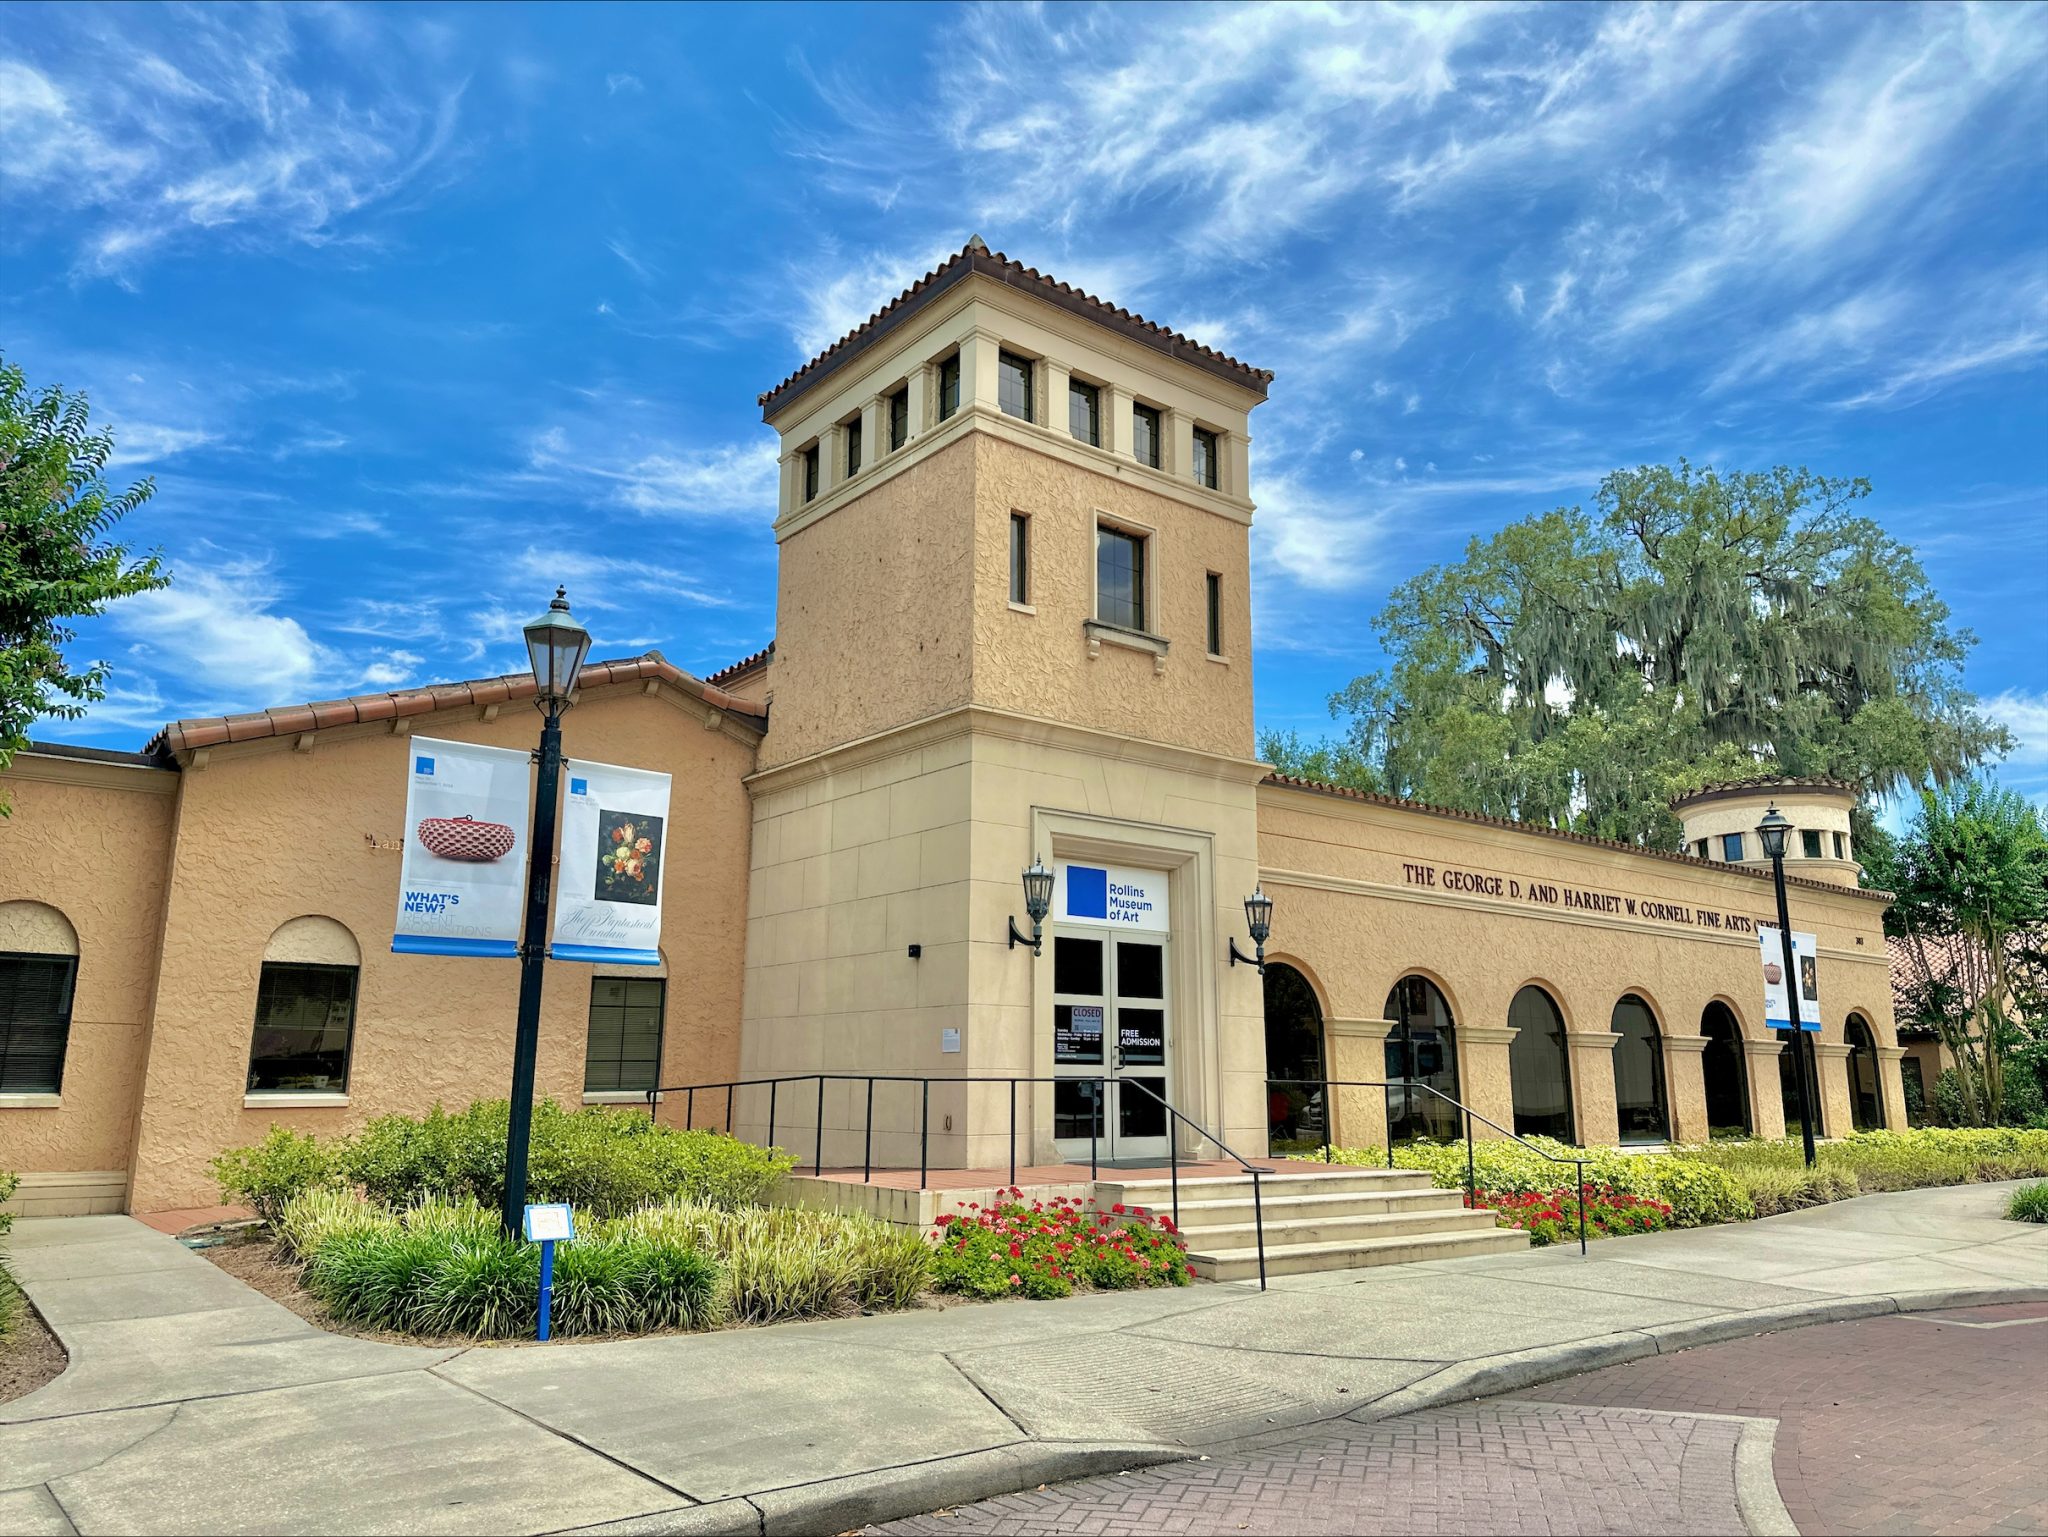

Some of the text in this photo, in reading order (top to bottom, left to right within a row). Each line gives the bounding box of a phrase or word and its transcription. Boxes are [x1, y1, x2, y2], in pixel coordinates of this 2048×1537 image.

[1109, 883, 1144, 898] Rollins
[405, 891, 460, 905] WHAT'S
[1109, 896, 1152, 911] Museum
[1403, 863, 1436, 886] THE
[1442, 870, 1504, 896] GEORGE
[1509, 879, 1522, 899] D.
[1528, 883, 1558, 904] AND
[1563, 888, 1621, 913] HARRIET
[1624, 898, 1637, 916] W.
[1641, 901, 1694, 924] CORNELL
[1696, 909, 1721, 928] FINE
[1725, 914, 1751, 933] ARTS
[404, 901, 446, 914] NEW?
[560, 905, 592, 924] The
[402, 912, 457, 926] RECENT
[591, 906, 657, 930] Fantastical
[1109, 909, 1139, 923] of Art
[401, 922, 493, 937] ACQUISITIONS
[560, 917, 628, 939] Mundane
[1073, 1008, 1101, 1018] CLOSED
[1121, 1029, 1139, 1038] FREE
[1121, 1037, 1160, 1047] ADMISSION
